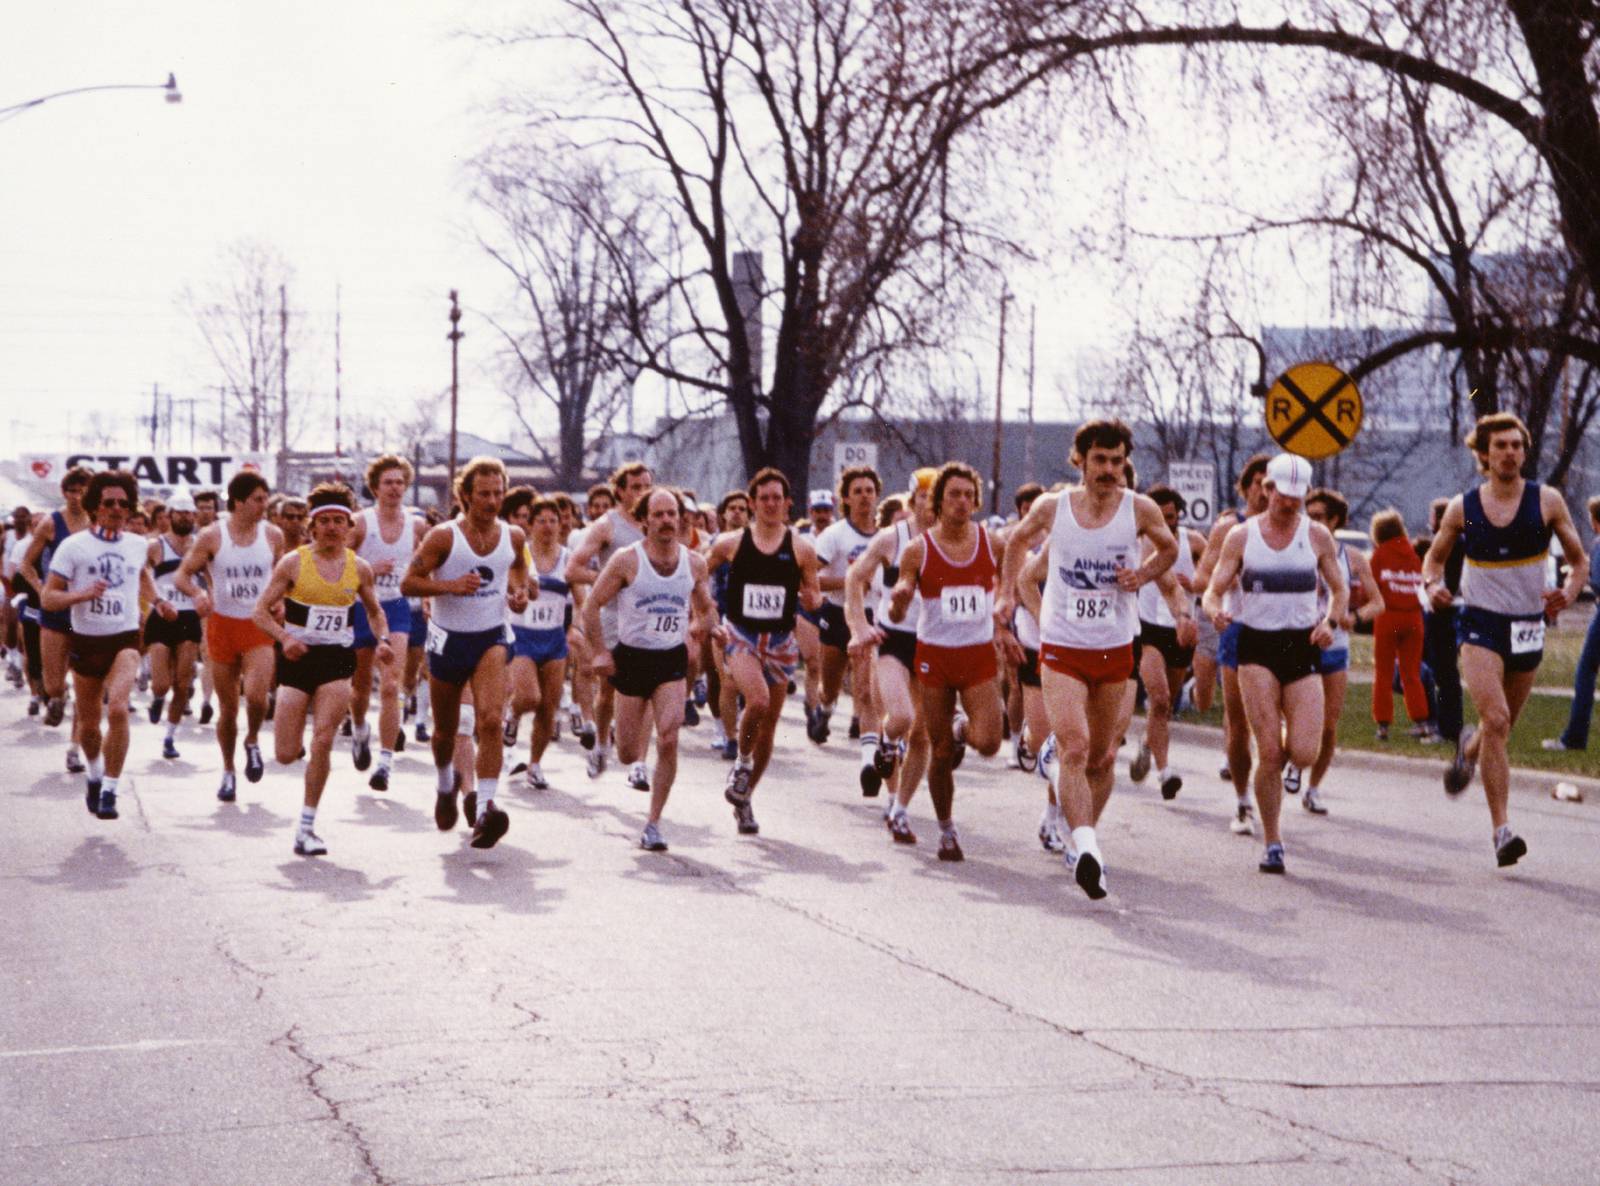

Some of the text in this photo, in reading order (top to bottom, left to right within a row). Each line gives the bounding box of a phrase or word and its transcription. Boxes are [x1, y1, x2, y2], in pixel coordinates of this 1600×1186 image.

[1272, 397, 1355, 421] R R
[845, 446, 866, 461] DO
[1095, 571, 1118, 584] Foo
[90, 597, 121, 616] 1510
[749, 591, 781, 611] 1383
[949, 596, 976, 613] 914
[1076, 598, 1108, 618] 982
[315, 615, 342, 631] 279
[654, 615, 680, 632] 105
